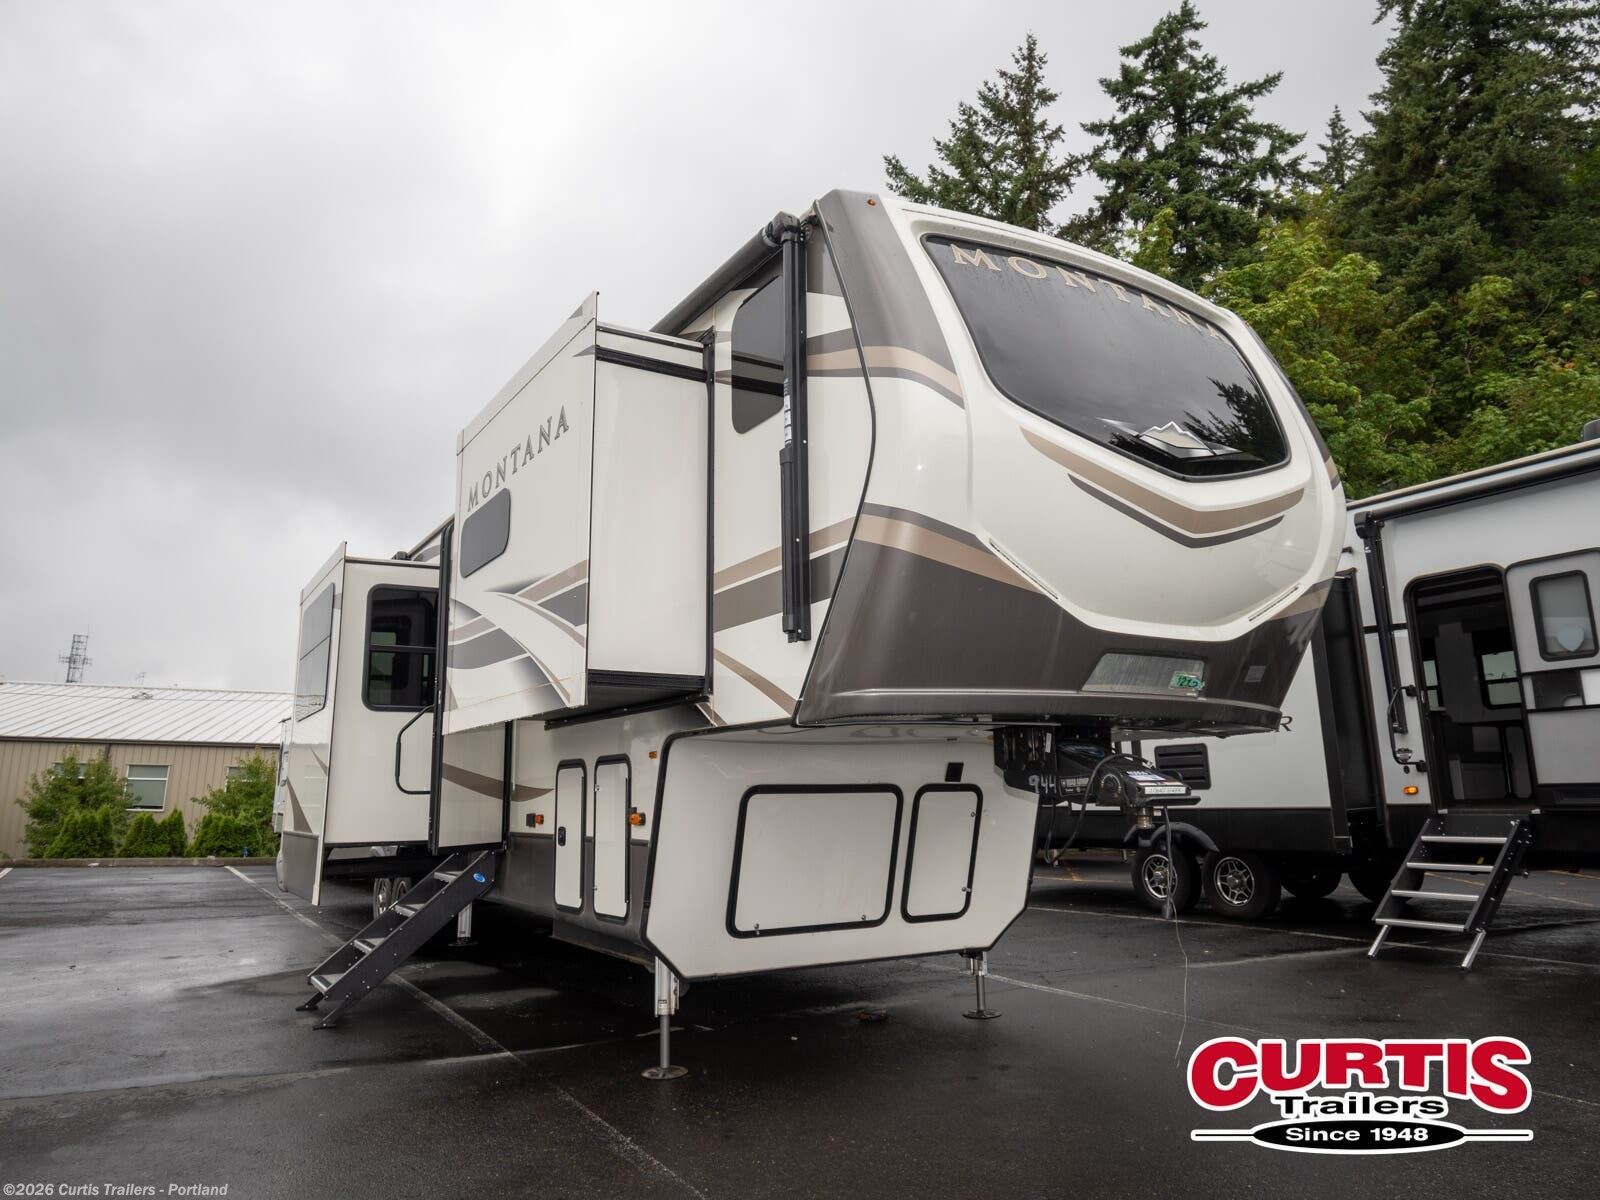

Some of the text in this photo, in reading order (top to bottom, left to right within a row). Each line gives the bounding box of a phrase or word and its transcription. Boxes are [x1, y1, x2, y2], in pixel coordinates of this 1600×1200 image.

[950, 243, 1232, 347] MONTANA
[467, 404, 570, 513] MONTANA
[1028, 774, 1057, 794] 944
